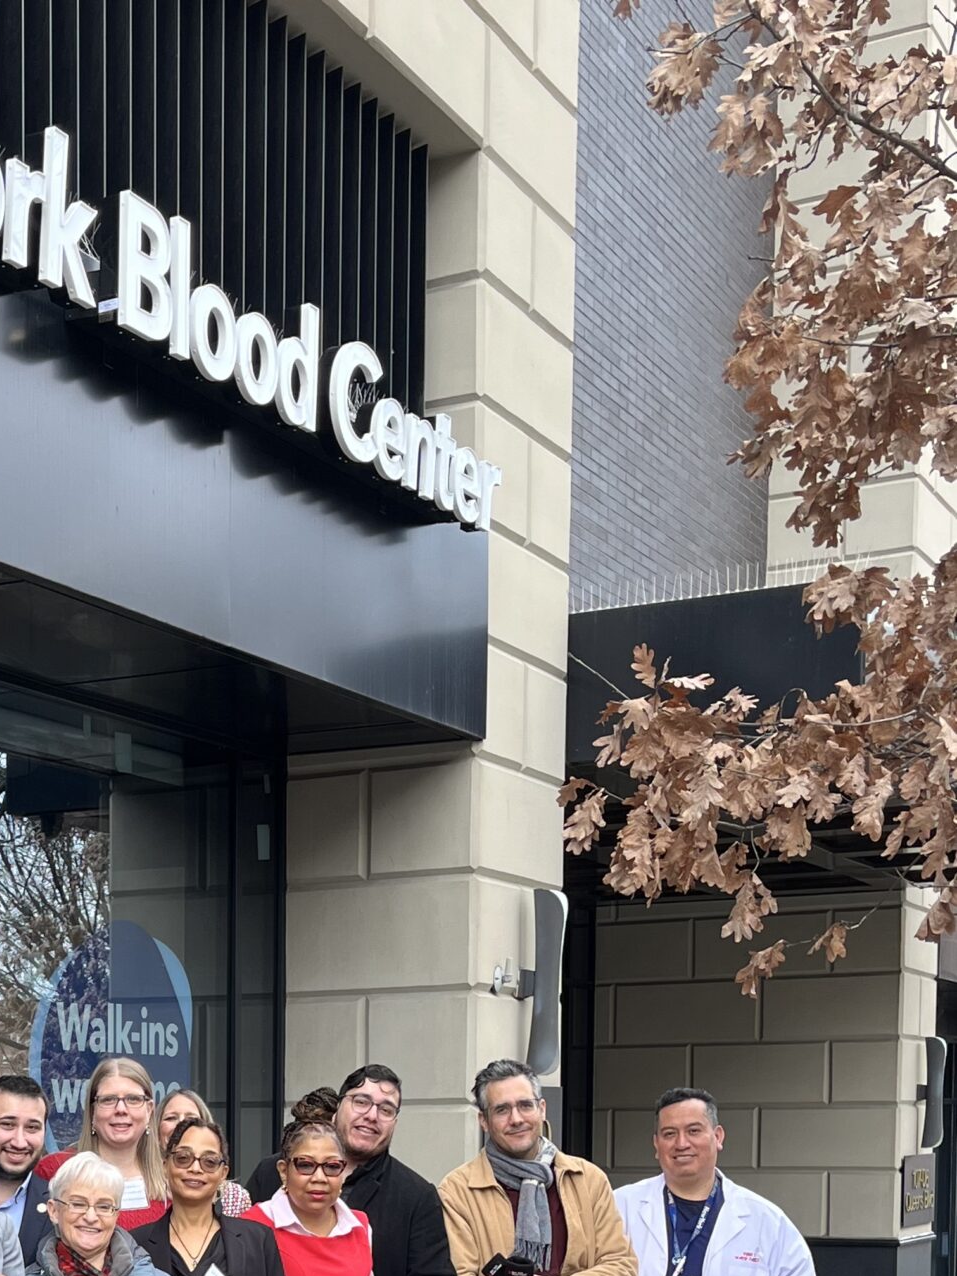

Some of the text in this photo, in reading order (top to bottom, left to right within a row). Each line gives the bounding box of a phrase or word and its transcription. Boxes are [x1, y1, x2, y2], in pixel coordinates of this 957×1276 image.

[117, 189, 320, 433] Blood
[329, 341, 502, 532] Center
[56, 1001, 179, 1057] Walk-ins
